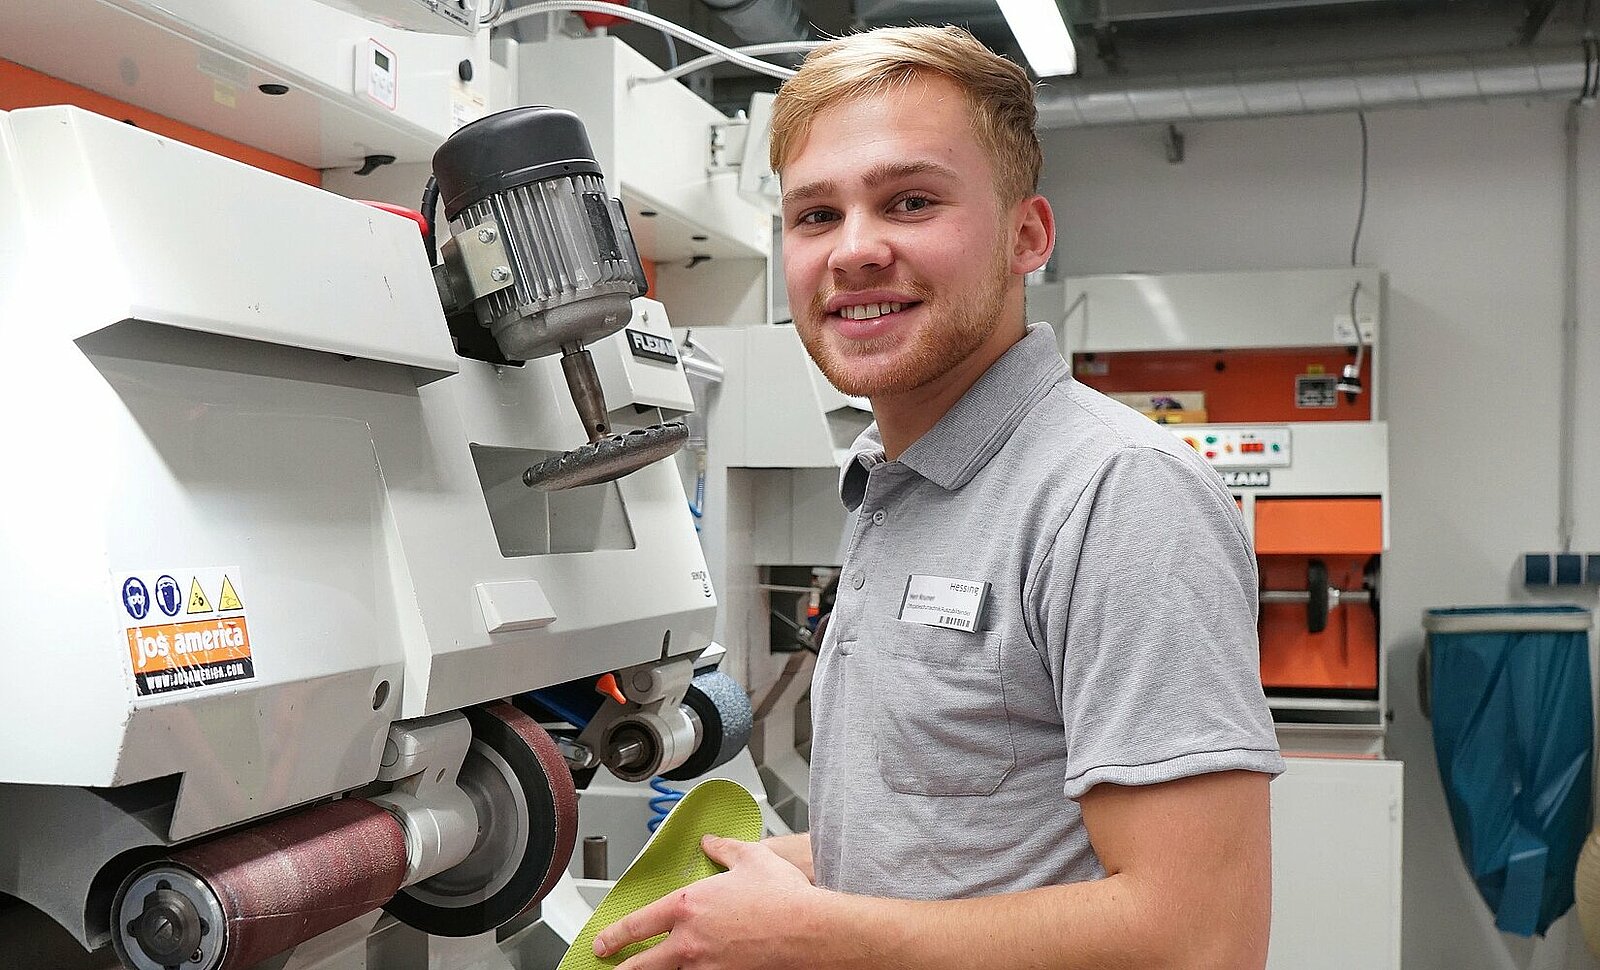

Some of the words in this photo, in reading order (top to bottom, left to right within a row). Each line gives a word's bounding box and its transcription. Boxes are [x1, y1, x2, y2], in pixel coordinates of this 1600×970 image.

[950, 583, 979, 596] Hessing
[135, 627, 169, 668] jos
[174, 619, 245, 655] america
